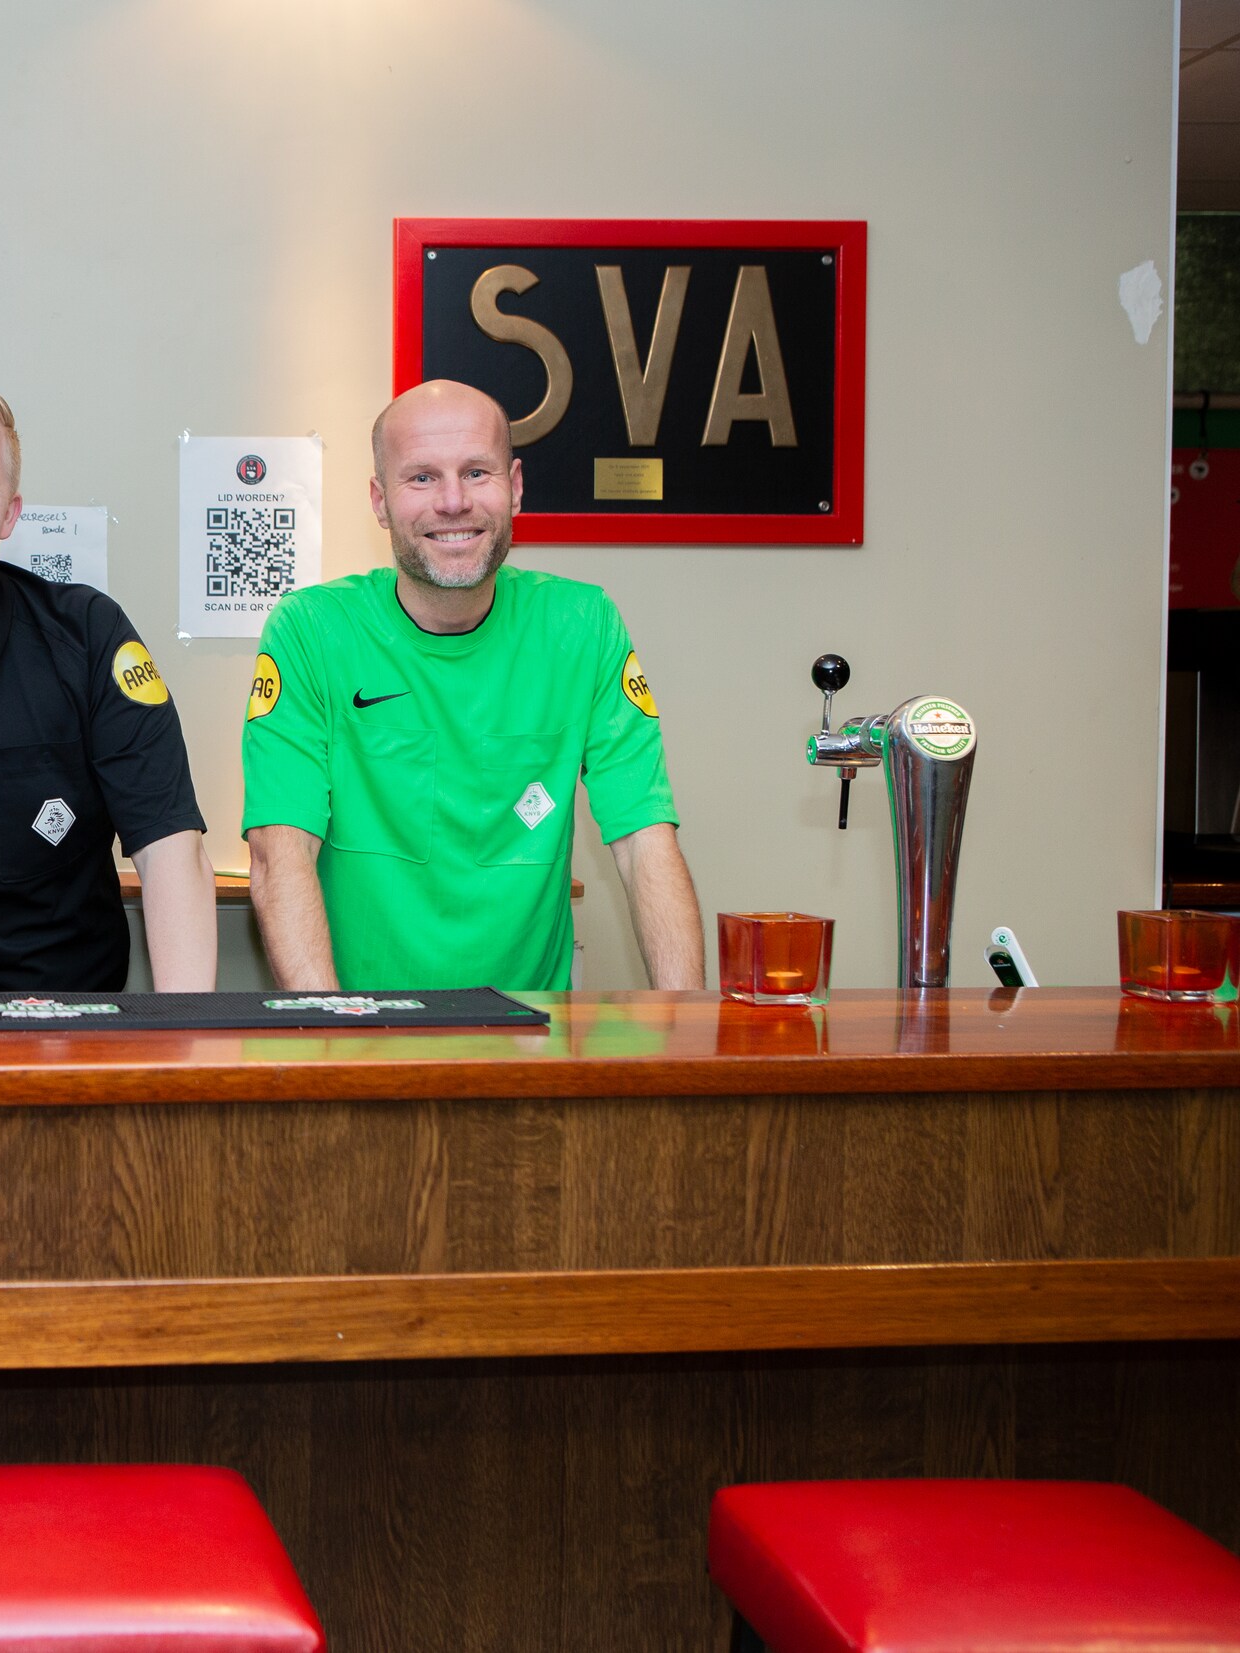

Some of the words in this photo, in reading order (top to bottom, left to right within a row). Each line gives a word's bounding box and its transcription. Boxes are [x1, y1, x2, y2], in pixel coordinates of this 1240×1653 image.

[470, 264, 798, 448] SVA
[217, 494, 233, 502] LID
[236, 494, 285, 502] WORDEN?
[204, 603, 231, 611] SCAN
[234, 603, 247, 611] DE
[249, 603, 264, 611] QR
[251, 677, 274, 699] AG
[628, 675, 651, 697] AR
[913, 723, 969, 734] Heineken
